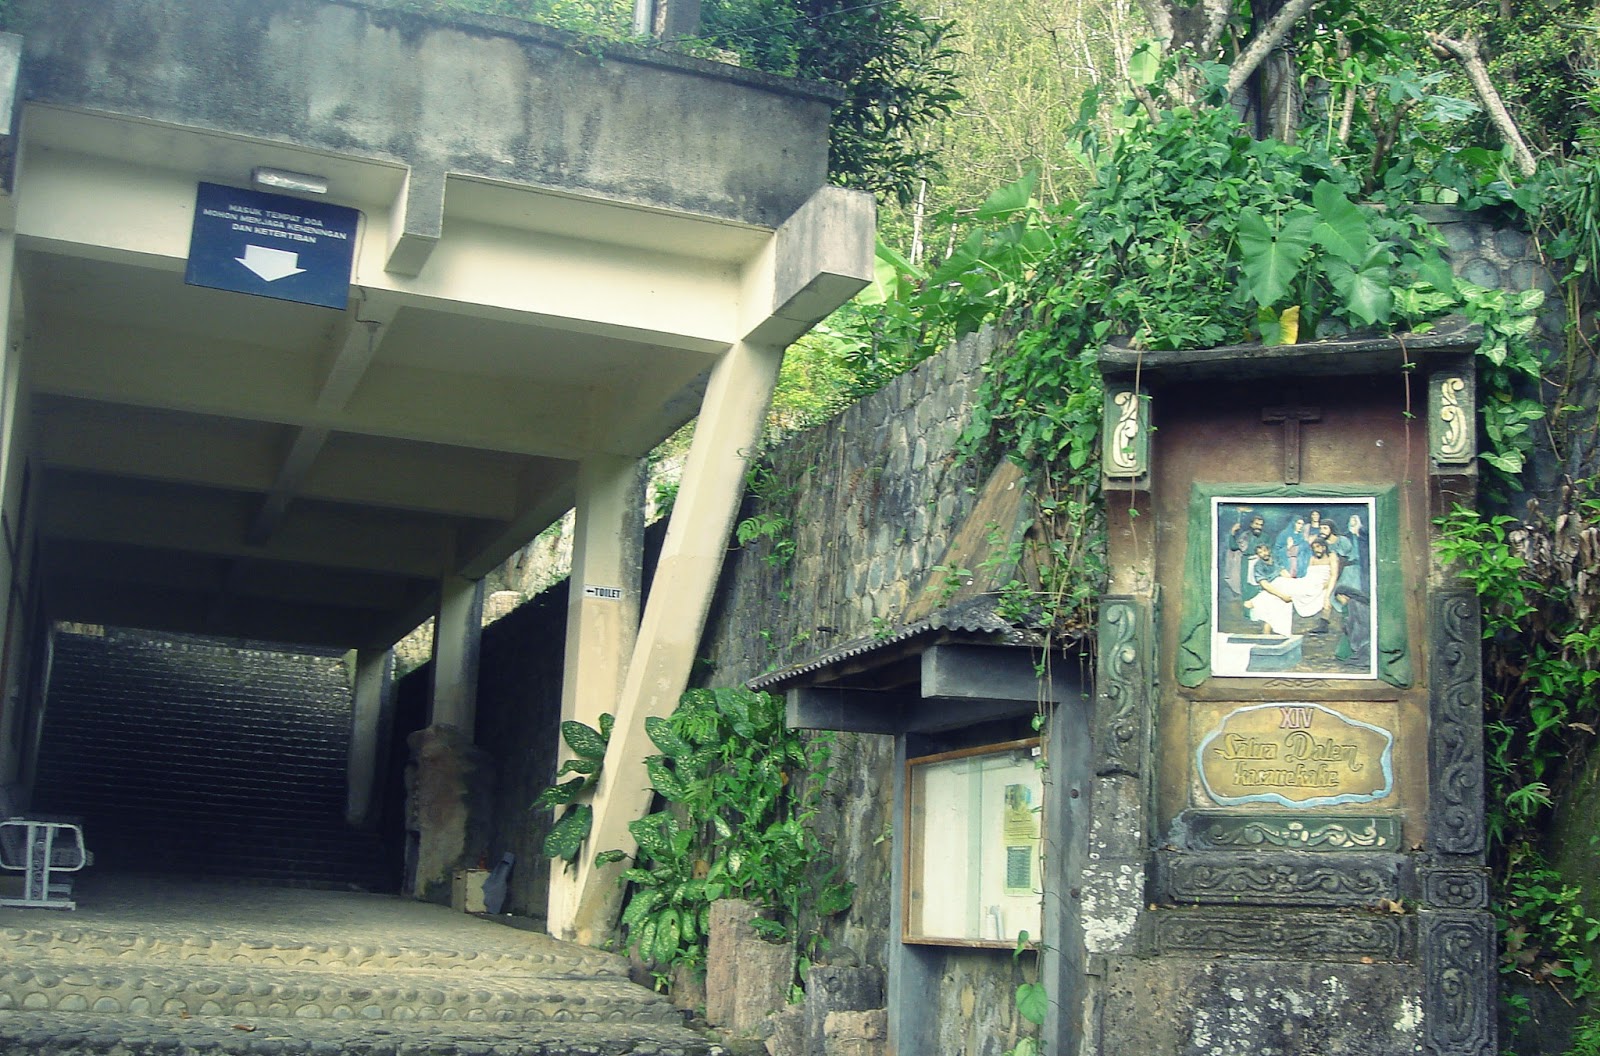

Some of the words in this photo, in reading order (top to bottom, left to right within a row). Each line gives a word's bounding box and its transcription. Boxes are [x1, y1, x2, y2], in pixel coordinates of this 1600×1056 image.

[203, 208, 238, 221] MOHON
[240, 215, 285, 229] MENJAGA
[287, 223, 347, 240] KEHENINGAN
[229, 204, 262, 216] MASUK
[266, 210, 302, 222] TEMPAT
[304, 217, 324, 227] DOA
[232, 223, 252, 234] DAN
[254, 228, 317, 243] KETERTIBAN
[594, 587, 621, 598] TOILET
[1280, 707, 1314, 729] XIV
